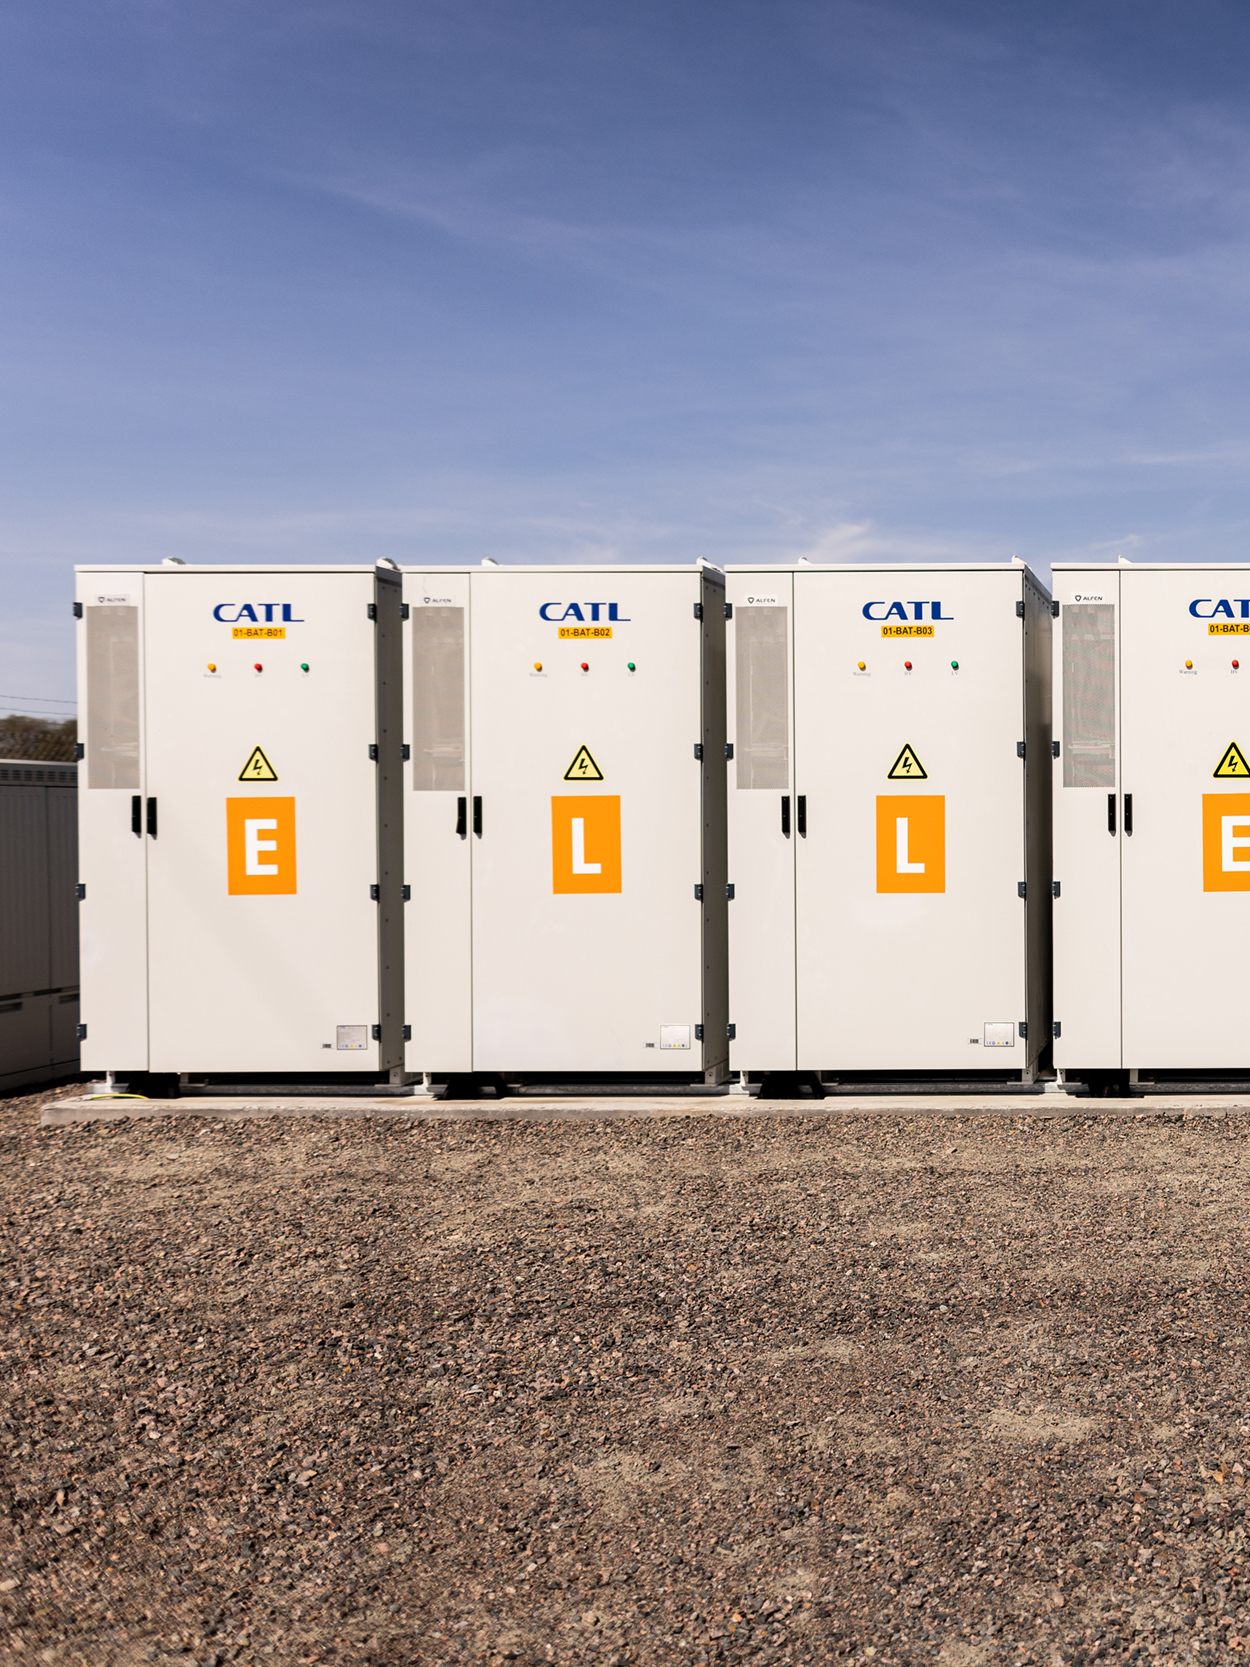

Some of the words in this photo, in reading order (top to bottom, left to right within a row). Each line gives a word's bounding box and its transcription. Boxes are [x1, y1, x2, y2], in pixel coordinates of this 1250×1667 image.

[213, 604, 304, 622] CATL
[539, 603, 630, 621] CATL
[863, 602, 954, 620] CATL
[234, 629, 283, 637] 01-BAT-B01
[560, 628, 610, 637] 01-BAT-B02
[883, 627, 933, 636] 01-BAT-B03
[245, 819, 278, 875] E
[572, 818, 601, 874] L
[896, 818, 925, 873] L
